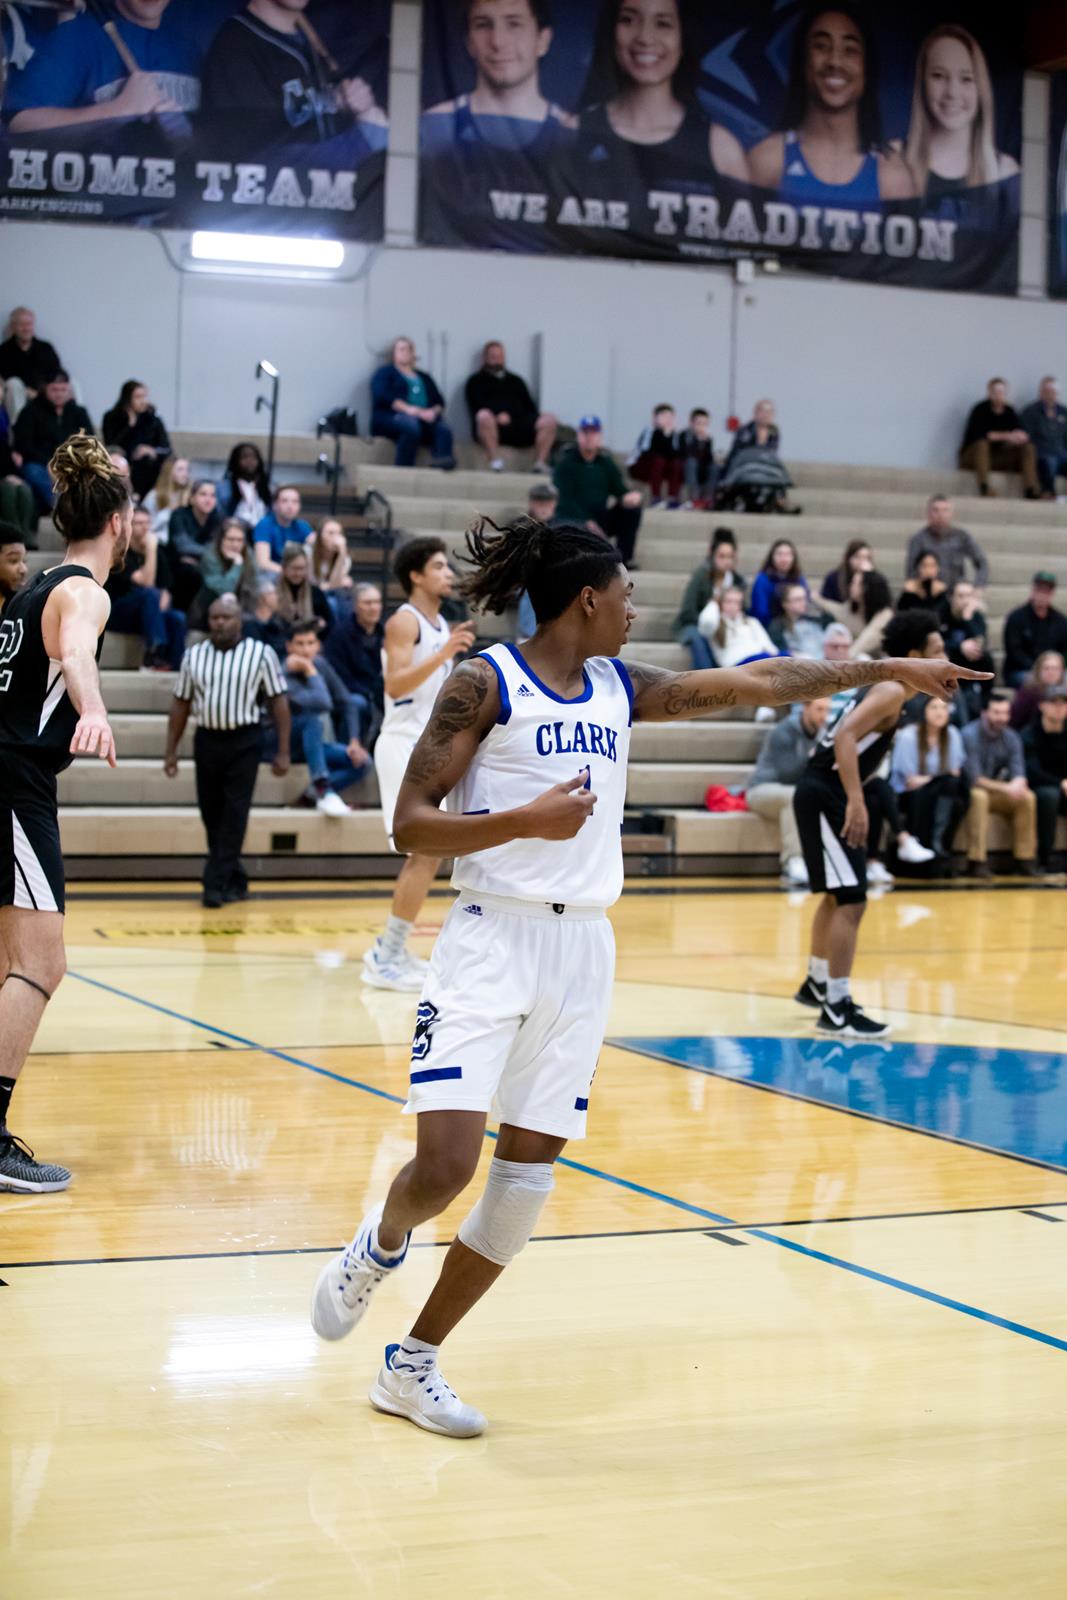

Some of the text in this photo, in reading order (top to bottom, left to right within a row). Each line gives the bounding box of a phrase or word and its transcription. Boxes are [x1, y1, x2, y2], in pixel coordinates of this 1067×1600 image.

[7, 150, 357, 211] HOME TEAM
[488, 190, 548, 224] WE
[556, 195, 629, 231] ARE
[647, 190, 958, 262] TRADITION
[535, 720, 619, 764] CLARK
